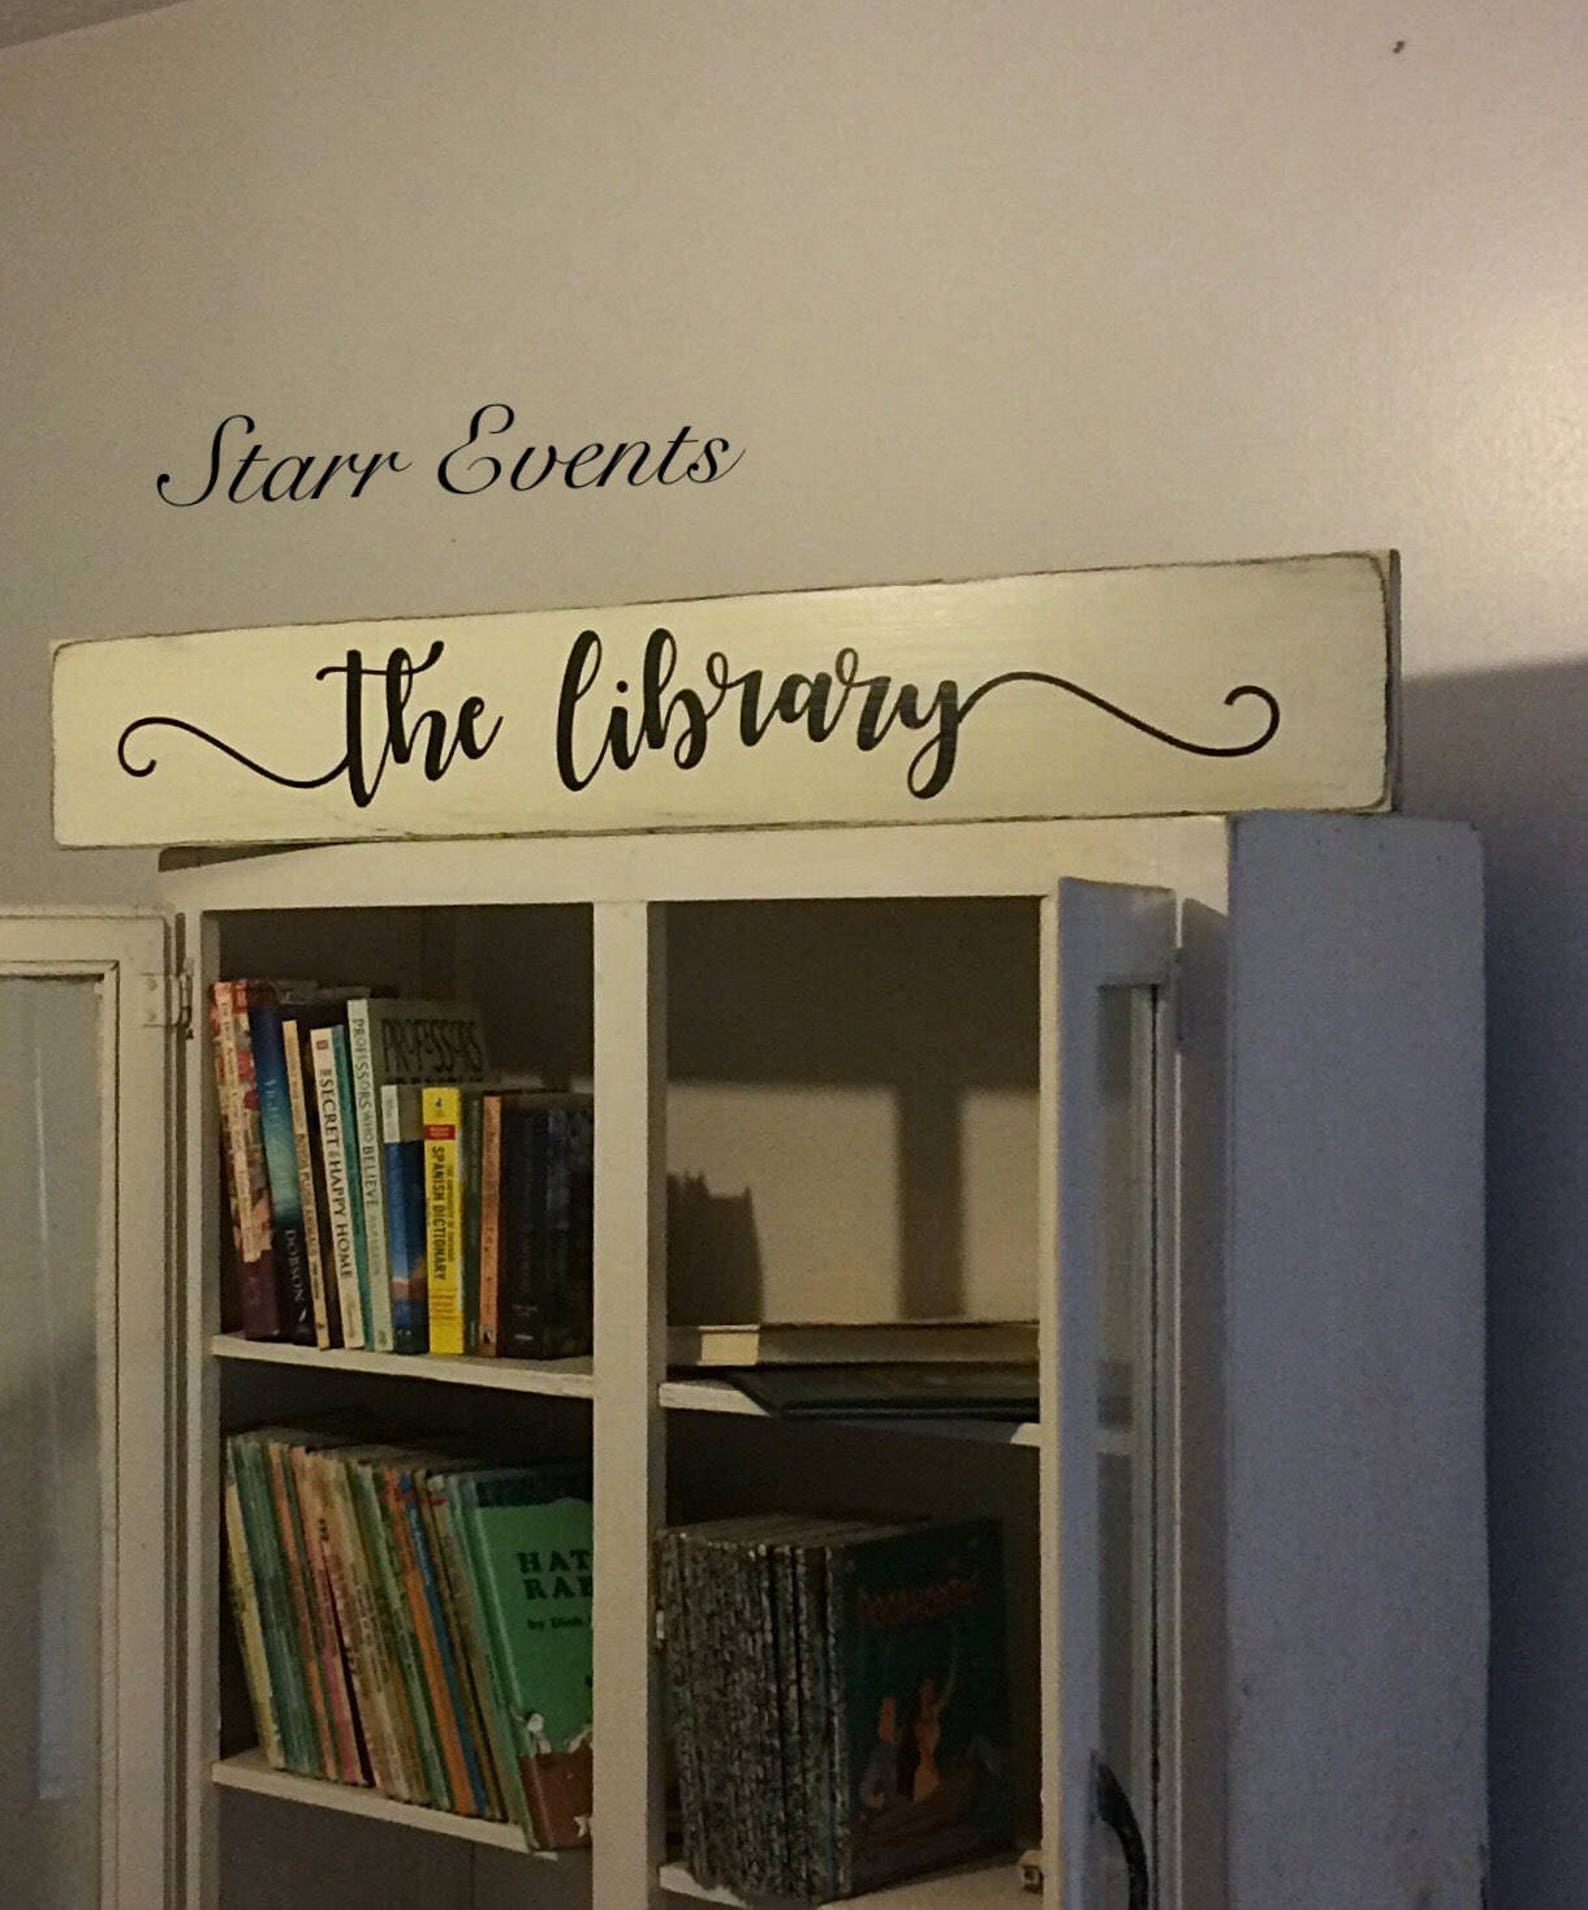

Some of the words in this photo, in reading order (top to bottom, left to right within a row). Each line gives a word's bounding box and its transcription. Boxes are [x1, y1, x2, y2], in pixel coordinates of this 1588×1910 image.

[300, 640, 503, 808] the
[556, 628, 966, 800] library
[319, 1078, 341, 1146] SECRET
[329, 1160, 346, 1216] HAPPY
[361, 1145, 379, 1205] BELIEVE
[431, 1145, 446, 1200] SPANISH
[283, 1228, 305, 1301] DOBSON
[335, 1223, 352, 1278] HOME
[431, 1204, 448, 1280] DICTIONARY
